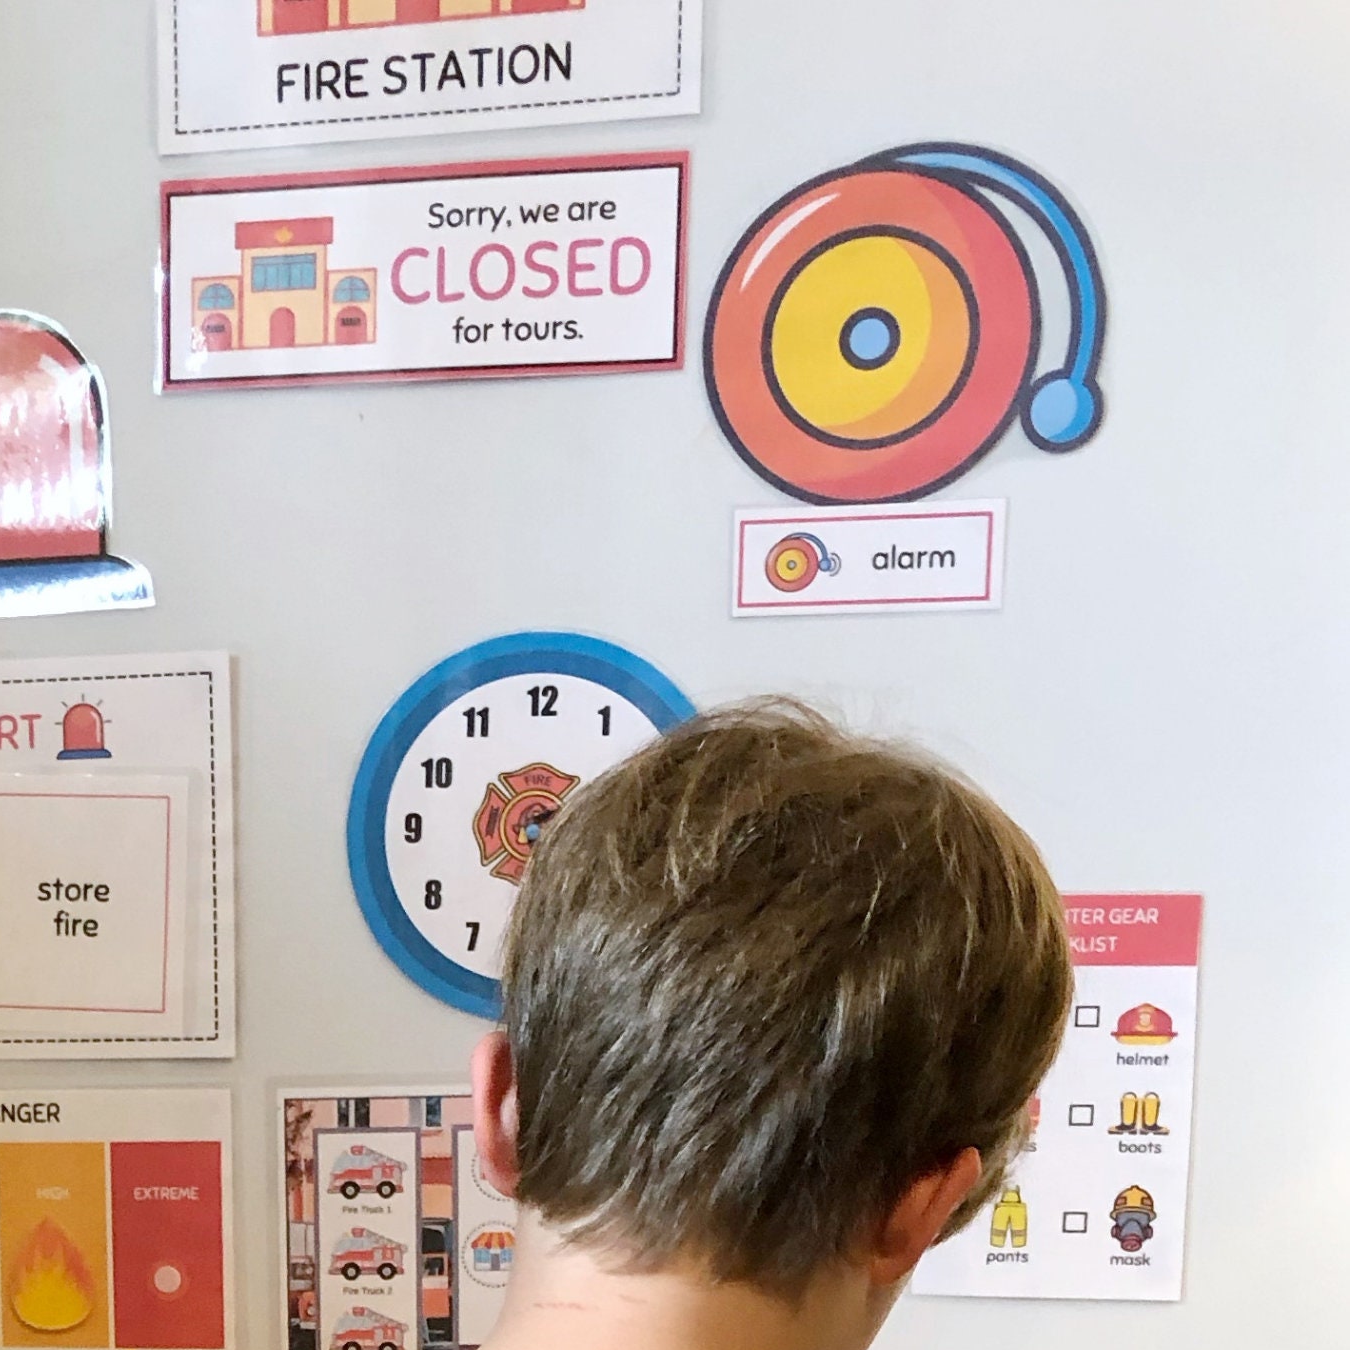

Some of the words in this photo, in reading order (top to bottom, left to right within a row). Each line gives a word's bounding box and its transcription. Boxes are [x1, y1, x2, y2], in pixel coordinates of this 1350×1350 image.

[275, 58, 369, 103] FIRE
[382, 41, 574, 95] STATION
[426, 202, 512, 231] Sorry,
[518, 201, 560, 224] we
[566, 198, 618, 223] are
[390, 235, 653, 305] CLOSED
[452, 316, 494, 344] for
[501, 314, 584, 342] tours.
[871, 544, 956, 572] alarm
[526, 685, 559, 717] 12
[462, 706, 490, 738] 11
[597, 705, 611, 736] 1
[421, 757, 453, 789] 10
[523, 774, 552, 787] FIRE
[404, 813, 423, 843] 9
[37, 876, 111, 903] store
[423, 879, 442, 910] 8
[53, 910, 100, 938] fire
[1108, 906, 1160, 925] GEAR
[465, 921, 480, 951] 7
[1115, 1052, 1170, 1067] helmet
[1118, 1140, 1163, 1155] boots
[133, 1186, 200, 1201] EXTREME
[985, 1250, 1030, 1266] pants
[1109, 1254, 1151, 1268] mask
